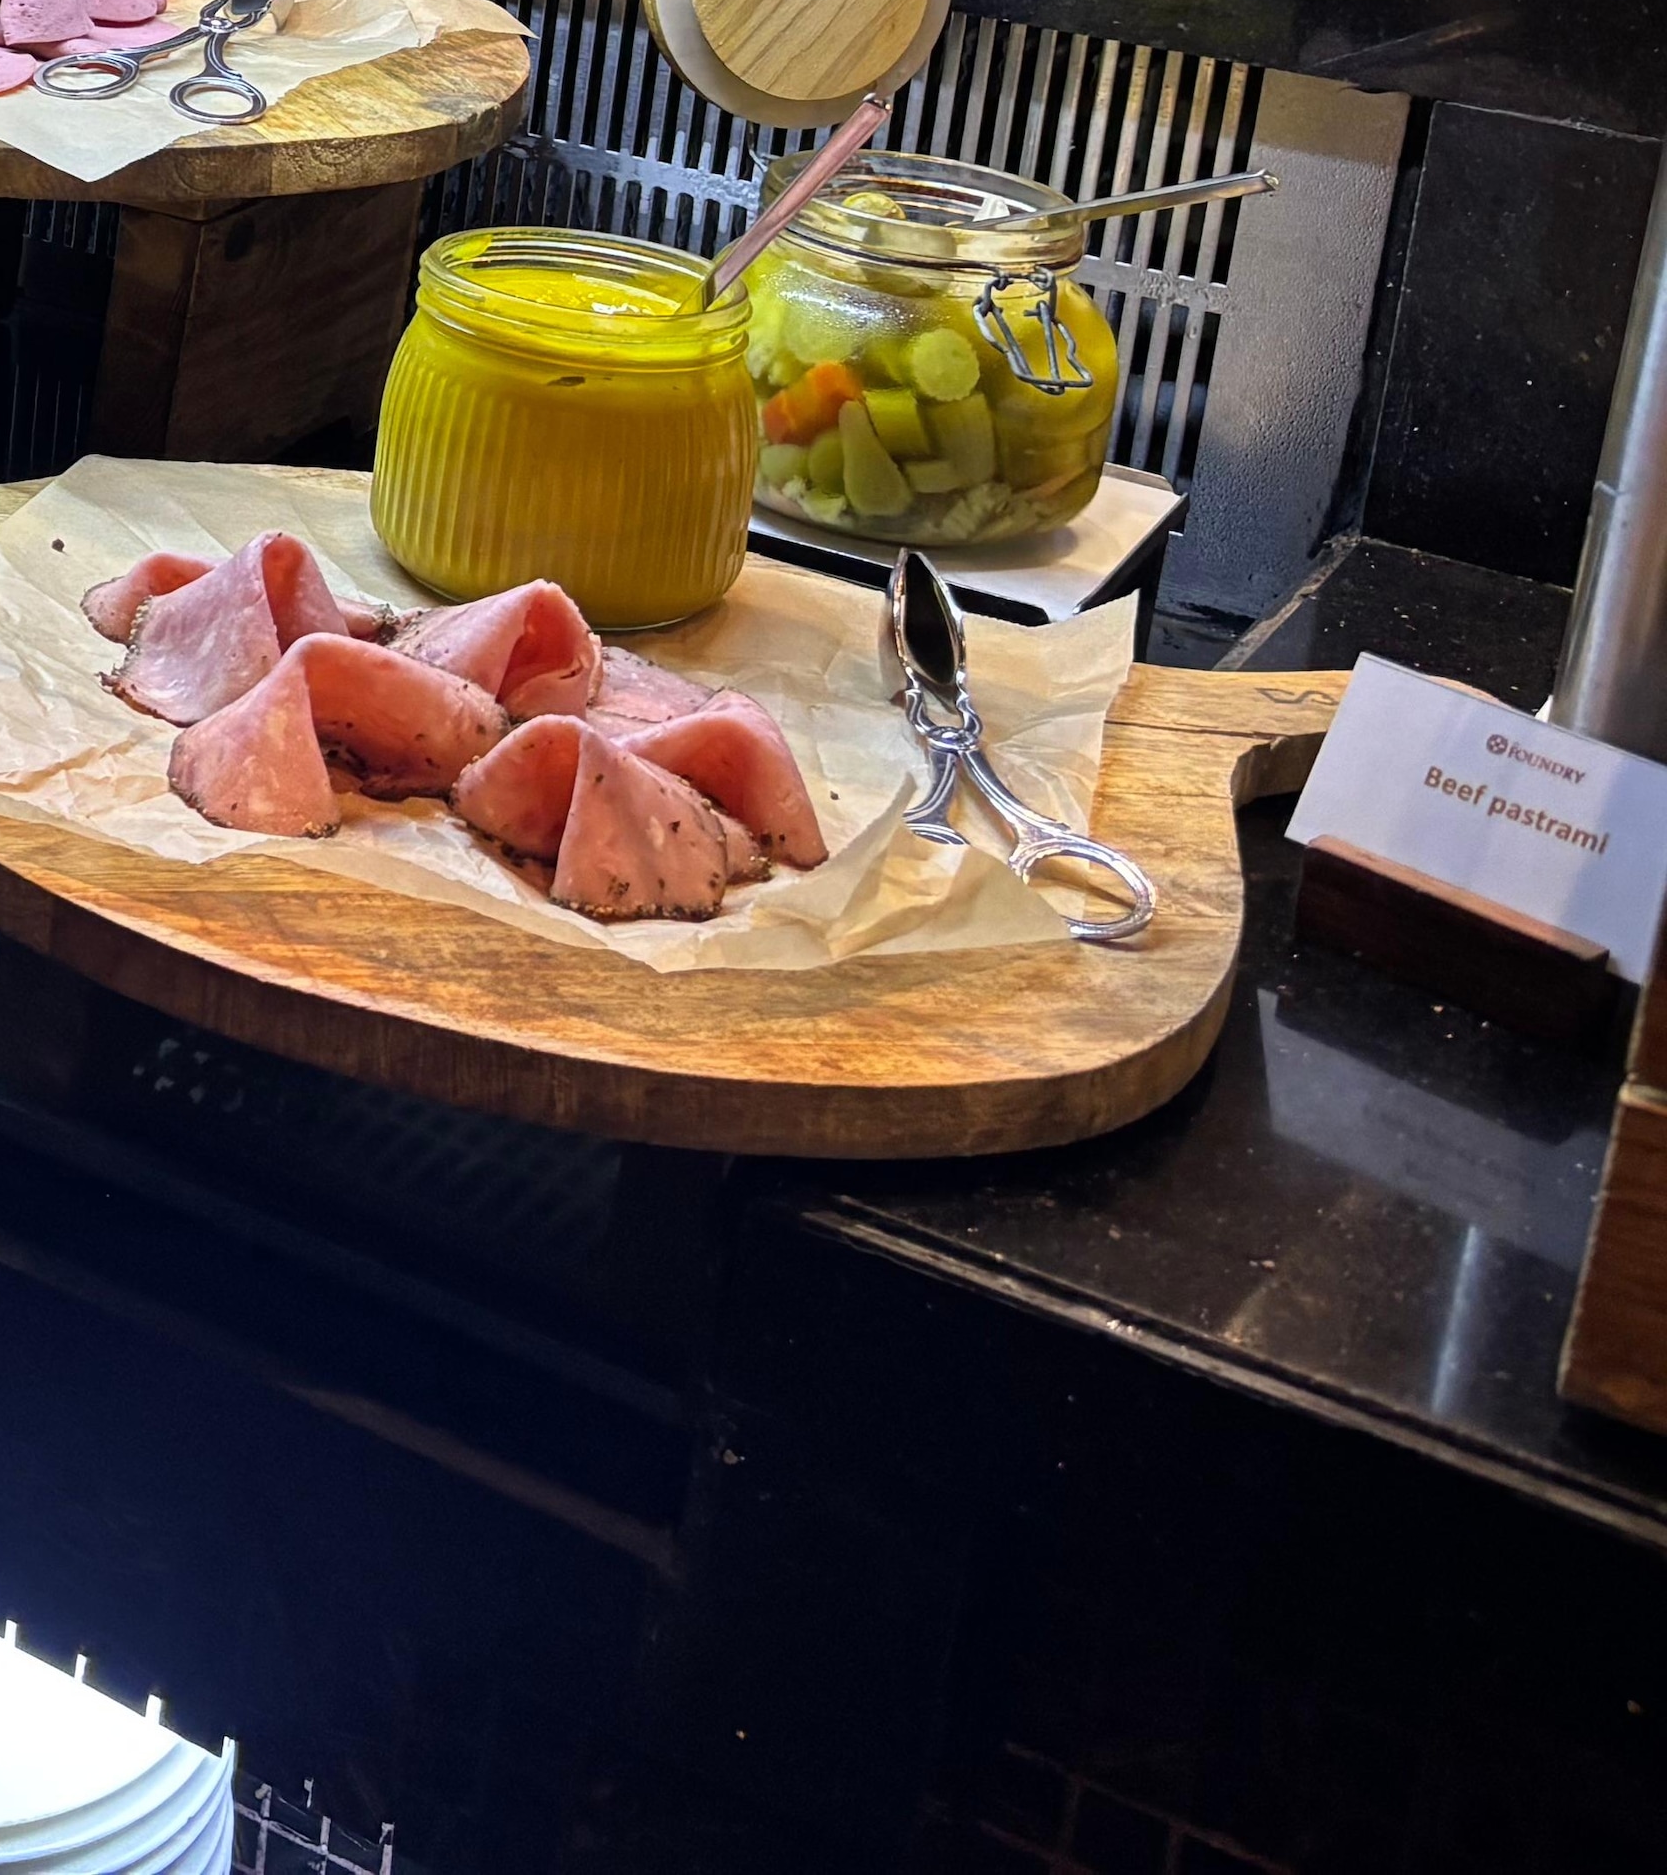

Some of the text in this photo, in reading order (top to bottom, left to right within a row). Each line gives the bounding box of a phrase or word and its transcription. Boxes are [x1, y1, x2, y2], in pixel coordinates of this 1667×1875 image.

[1508, 744, 1585, 784] FOUNDRY
[1423, 765, 1610, 856] Beef pastrami
